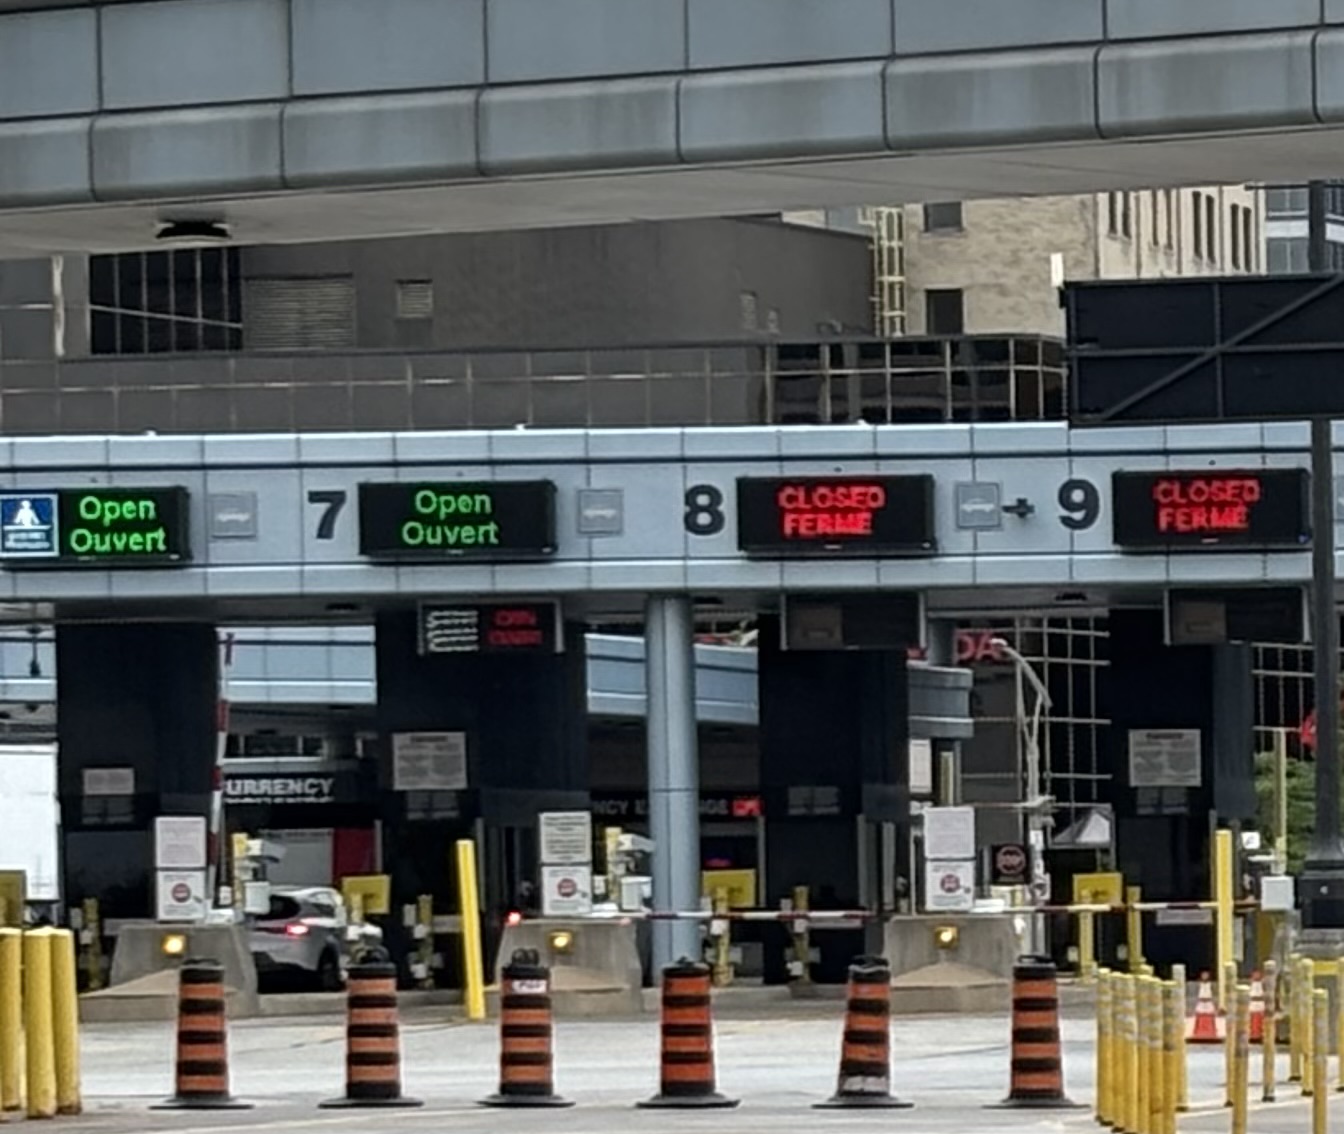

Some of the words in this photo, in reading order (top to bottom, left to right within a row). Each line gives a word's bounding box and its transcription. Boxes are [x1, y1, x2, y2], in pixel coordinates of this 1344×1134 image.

[415, 489, 492, 519] Open
[778, 486, 885, 508] CLOSED
[1057, 479, 1100, 530] 9
[1154, 479, 1260, 503] CLOSED
[79, 495, 156, 526] Open
[308, 490, 346, 539] 7
[684, 484, 725, 536] 8
[70, 526, 167, 552] Ouvert
[402, 520, 499, 545] Ouvert
[224, 779, 334, 796] URRENCY
